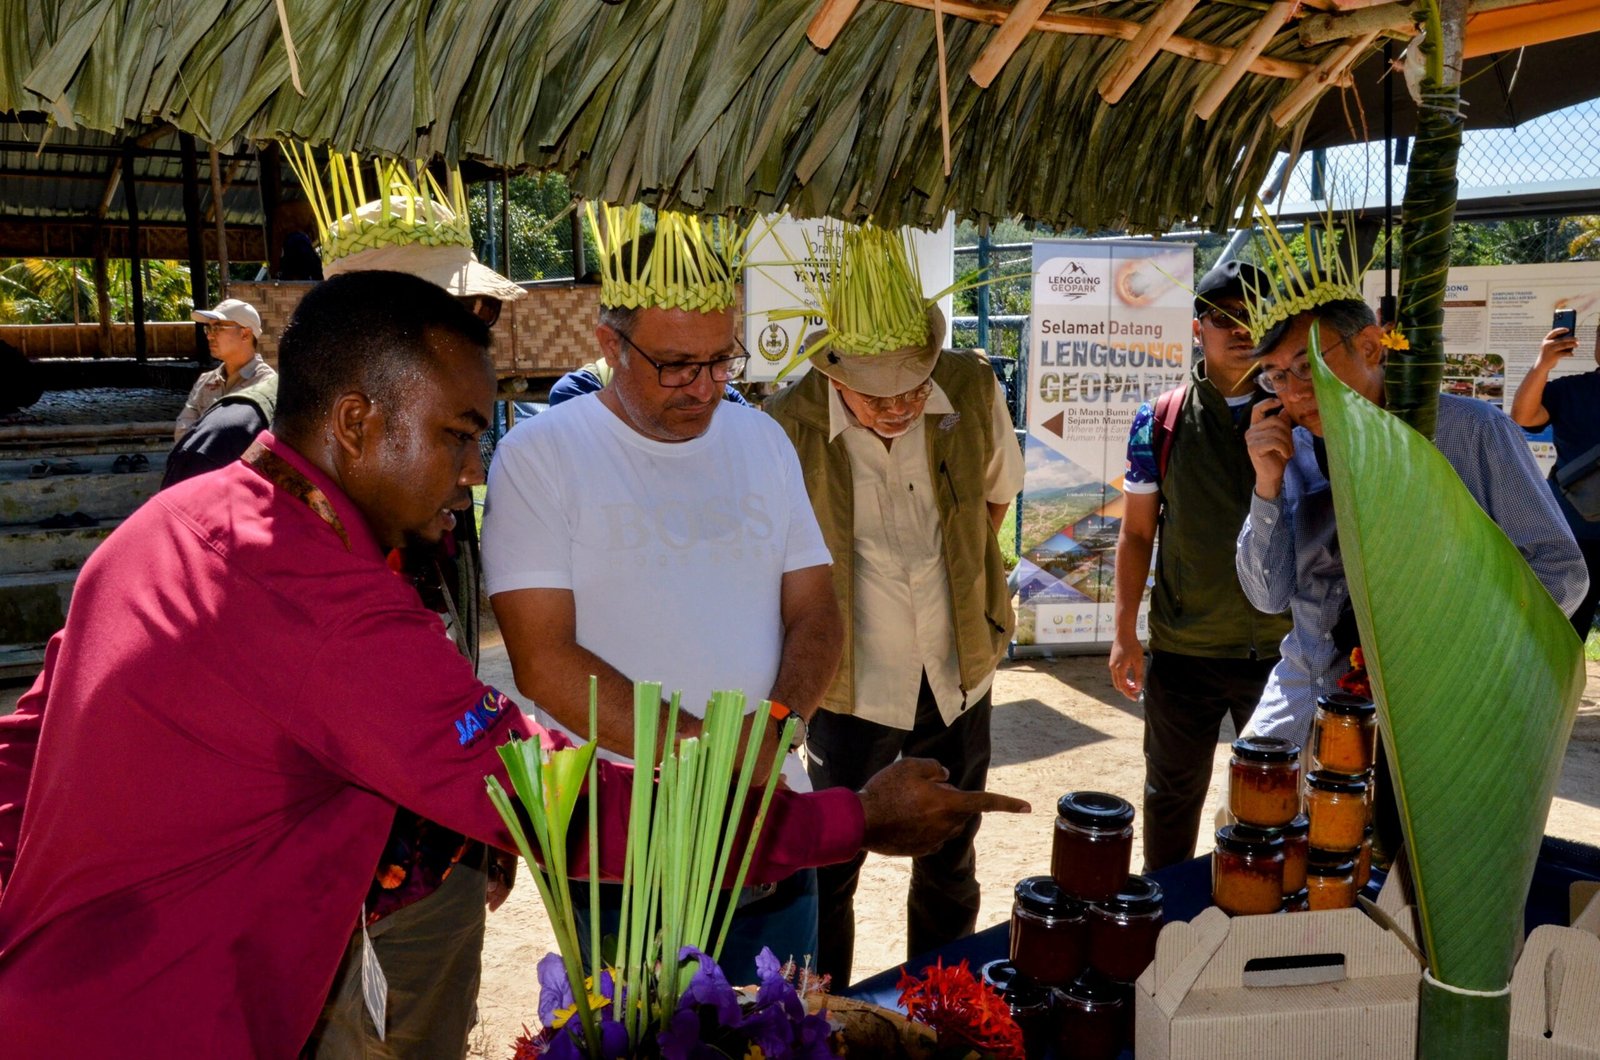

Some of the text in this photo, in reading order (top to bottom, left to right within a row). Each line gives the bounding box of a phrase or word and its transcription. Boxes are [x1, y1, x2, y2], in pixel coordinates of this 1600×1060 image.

[1048, 276, 1101, 285] LENGGONG
[1051, 284, 1096, 293] GEOPARK
[1041, 319, 1163, 339] Selamat Datang
[1040, 340, 1183, 368] LENGGONG
[1068, 408, 1077, 416] Di
[1080, 408, 1104, 416] Mana
[1106, 408, 1129, 416] Bumi
[1067, 416, 1100, 426] Sejarah
[600, 493, 774, 552] BOSS
